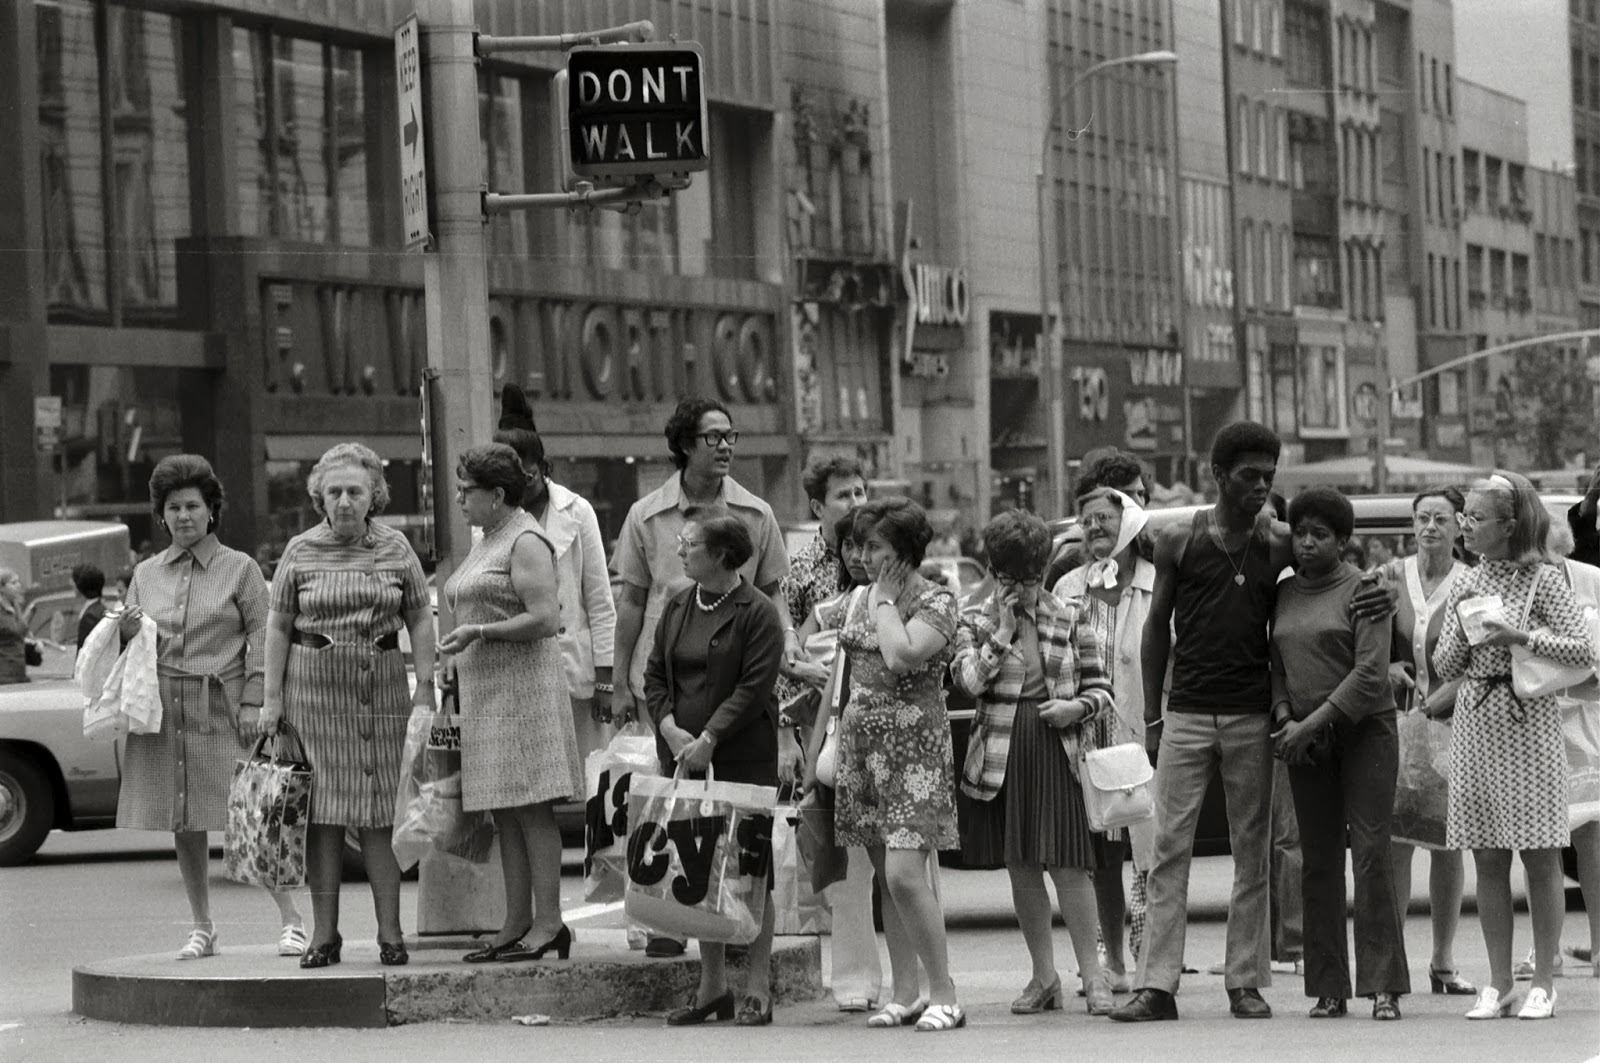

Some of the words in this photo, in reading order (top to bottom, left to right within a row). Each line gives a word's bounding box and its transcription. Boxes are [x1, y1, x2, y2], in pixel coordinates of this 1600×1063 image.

[399, 46, 416, 94] KEEP
[579, 66, 693, 104] DONT
[581, 121, 697, 160] WALK
[403, 170, 424, 218] RIGHT
